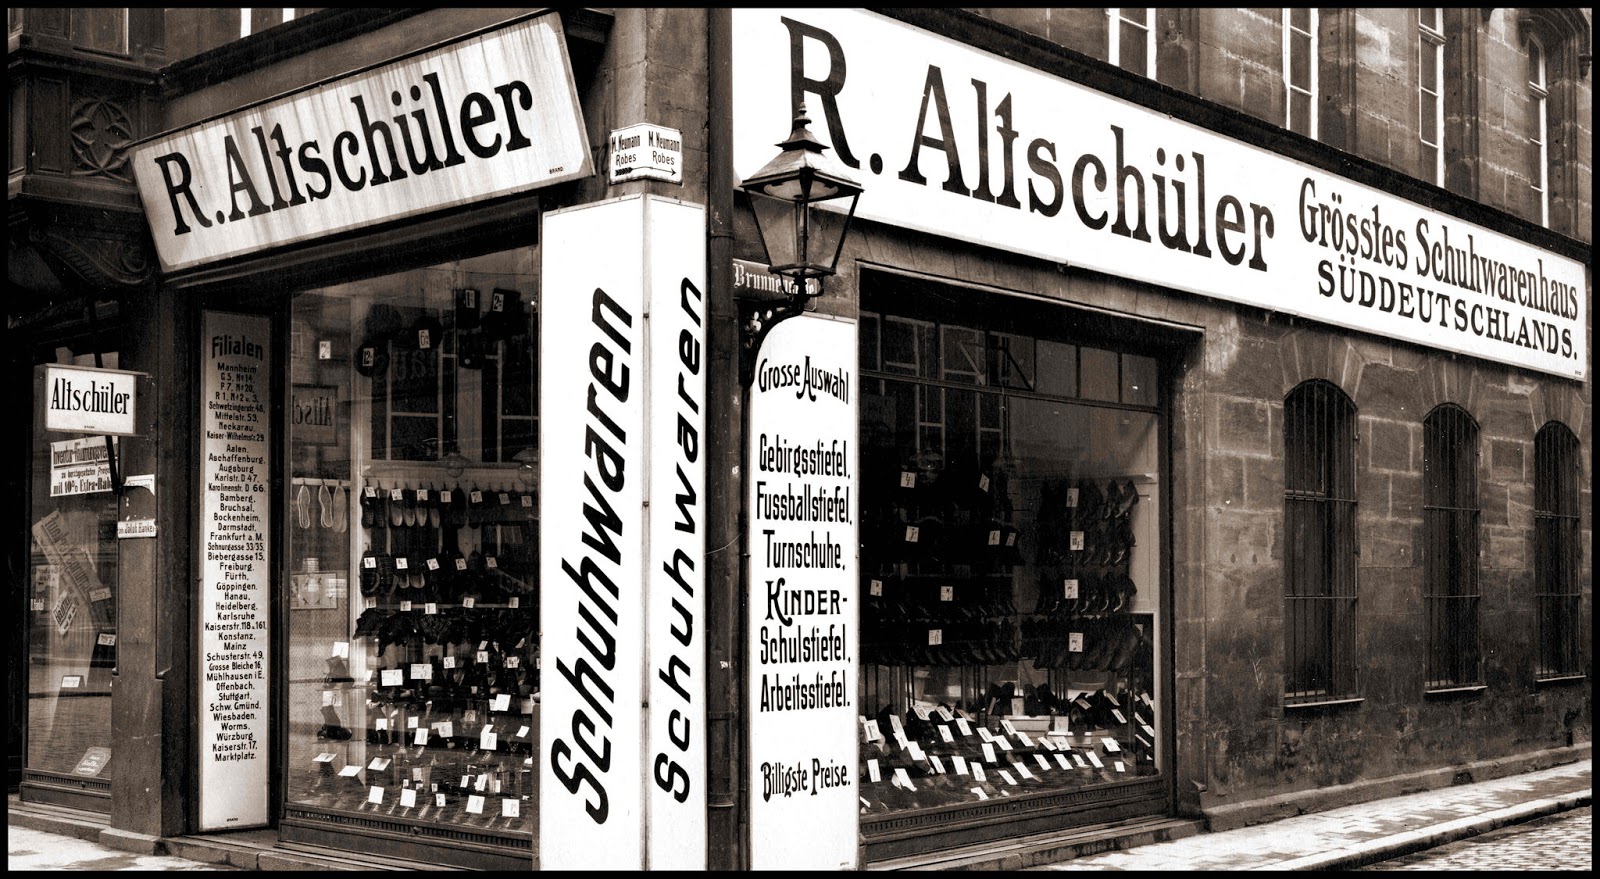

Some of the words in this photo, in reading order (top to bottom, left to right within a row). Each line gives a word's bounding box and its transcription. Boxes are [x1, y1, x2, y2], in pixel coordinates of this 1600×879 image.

[780, 16, 883, 175] R.
[898, 64, 1275, 272] Altschüler
[616, 153, 637, 167] Robes
[652, 150, 675, 166] Robes
[1299, 177, 1408, 271] Grösstes
[1416, 218, 1578, 321] Schuhwarenhaus
[1318, 254, 1578, 360] SÜDDEUTSCHLANDS.
[212, 335, 263, 361] Filialen
[217, 362, 257, 374] Mannheim
[758, 358, 801, 393] Grosse
[796, 355, 849, 405] Auswahl
[50, 377, 130, 415] Altschüler
[215, 391, 220, 400] R
[218, 463, 254, 474] Augsburg
[245, 483, 250, 492] D
[210, 531, 246, 541] Frankfurt
[654, 277, 703, 804] Schuhwaren
[207, 551, 254, 562] Biebergasse
[551, 287, 632, 825] Schuhwaren
[765, 577, 848, 627] KINDER-
[217, 611, 255, 621] Karlsruhe
[223, 642, 247, 651] Mainz
[208, 662, 230, 672] Grosse
[231, 661, 254, 671] Bleiche
[206, 672, 253, 682] Mühlhausen
[209, 702, 233, 712] Schw.
[216, 731, 254, 742] Würzburg
[760, 760, 808, 803] Billigste
[811, 758, 851, 796] Preise.
